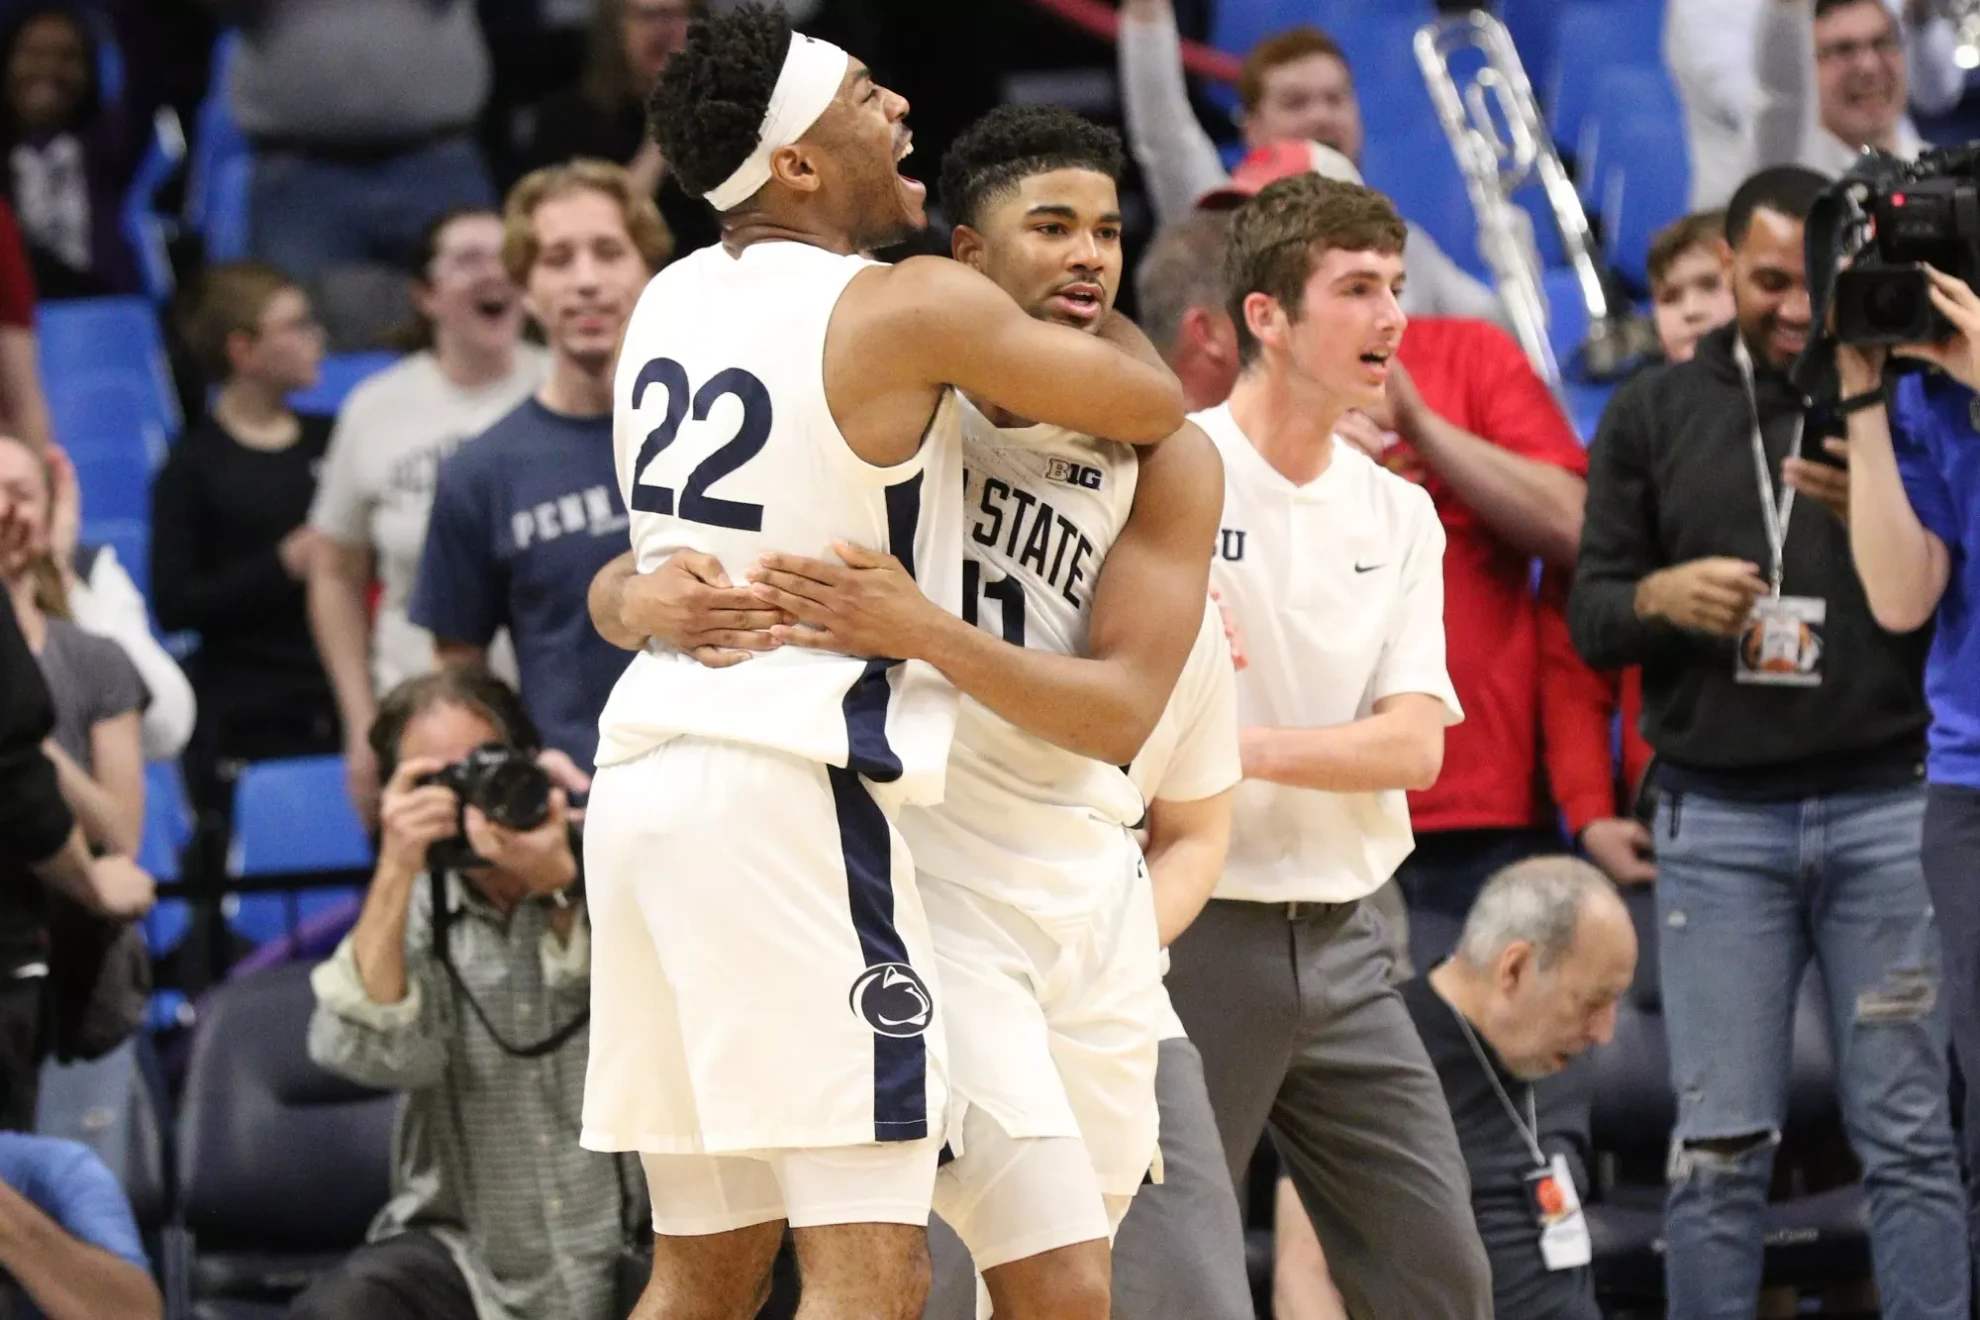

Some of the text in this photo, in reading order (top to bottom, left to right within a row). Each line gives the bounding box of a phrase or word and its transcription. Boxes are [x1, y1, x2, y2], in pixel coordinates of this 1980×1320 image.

[631, 357, 773, 532] 22
[972, 477, 1093, 610] STATE
[1212, 528, 1247, 561] U
